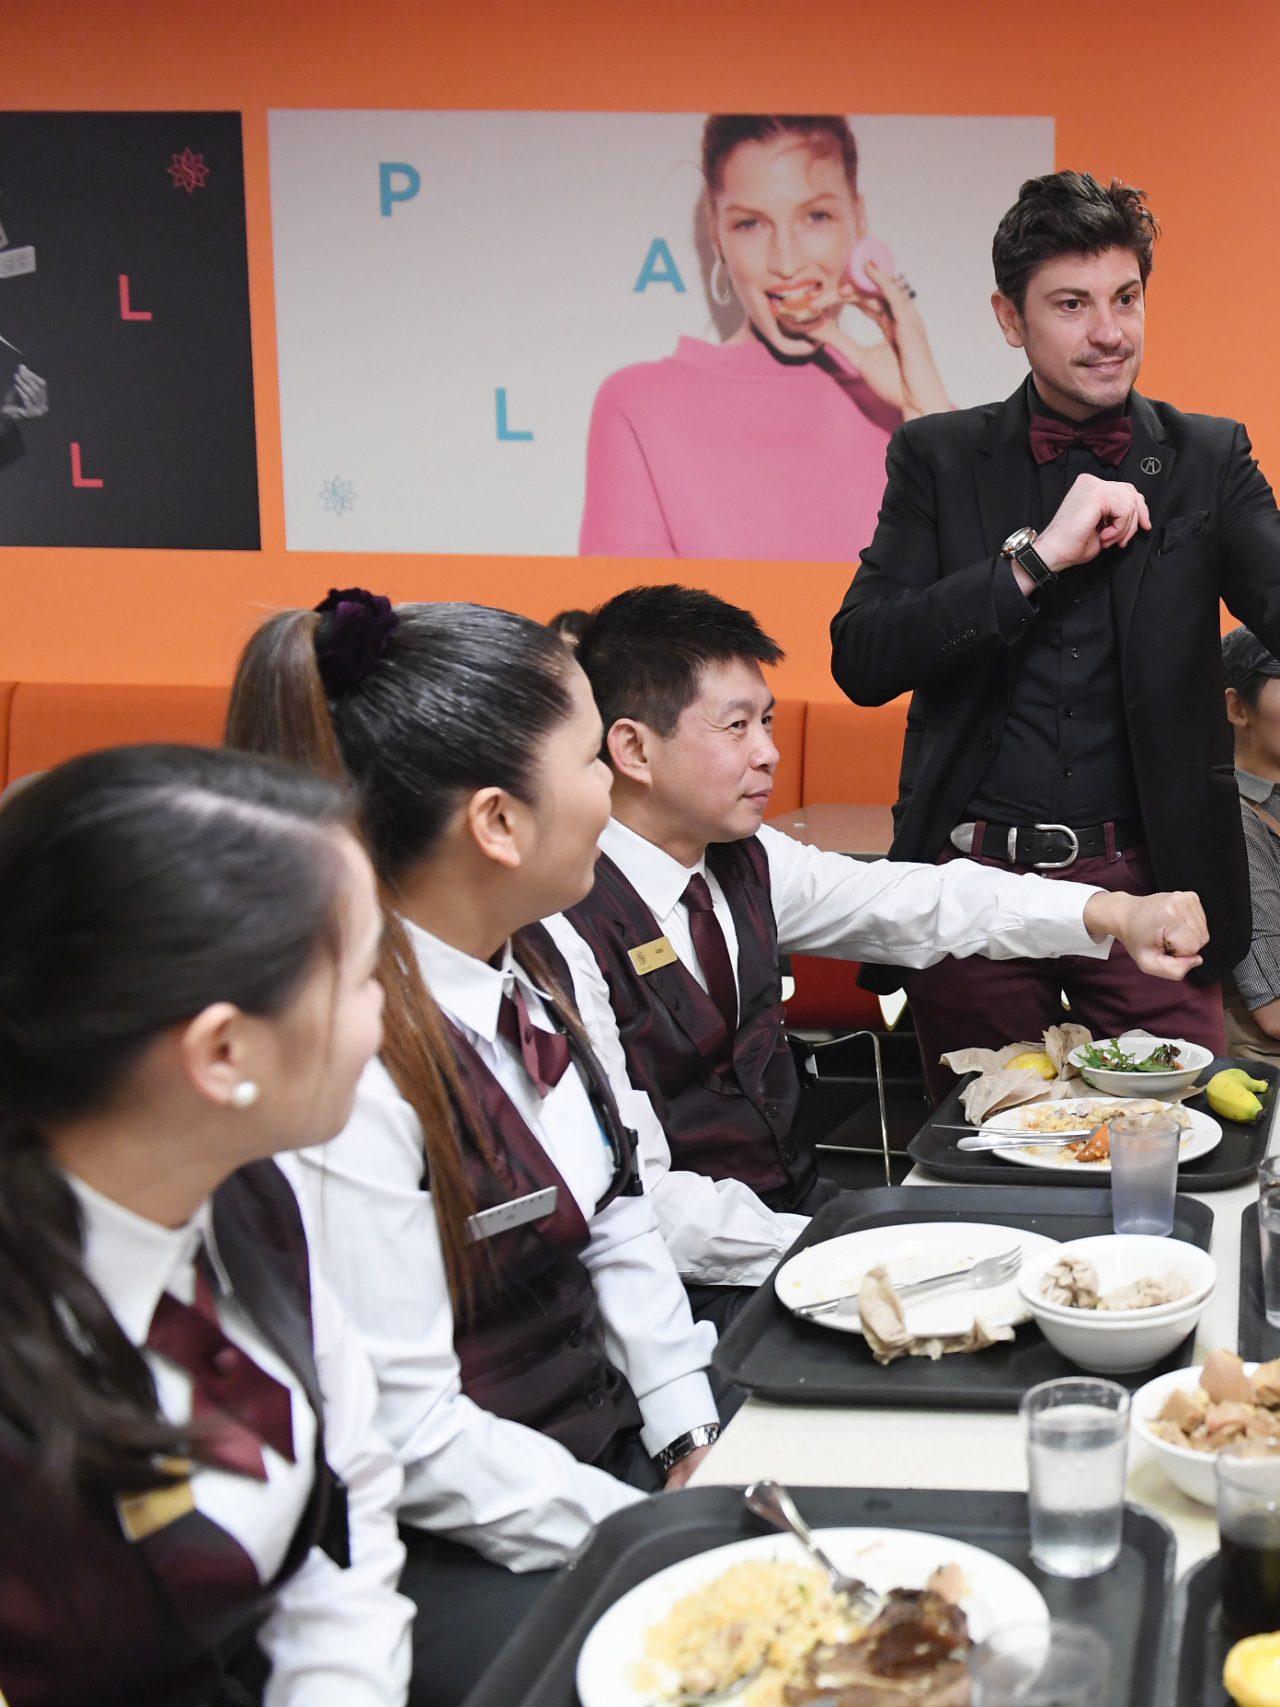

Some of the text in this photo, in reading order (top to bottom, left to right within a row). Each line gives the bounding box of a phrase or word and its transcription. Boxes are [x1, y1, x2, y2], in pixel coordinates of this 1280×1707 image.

[379, 162, 421, 217] P
[633, 238, 686, 293] A
[119, 274, 152, 321] L
[495, 388, 533, 441] L
[70, 441, 103, 488] L
